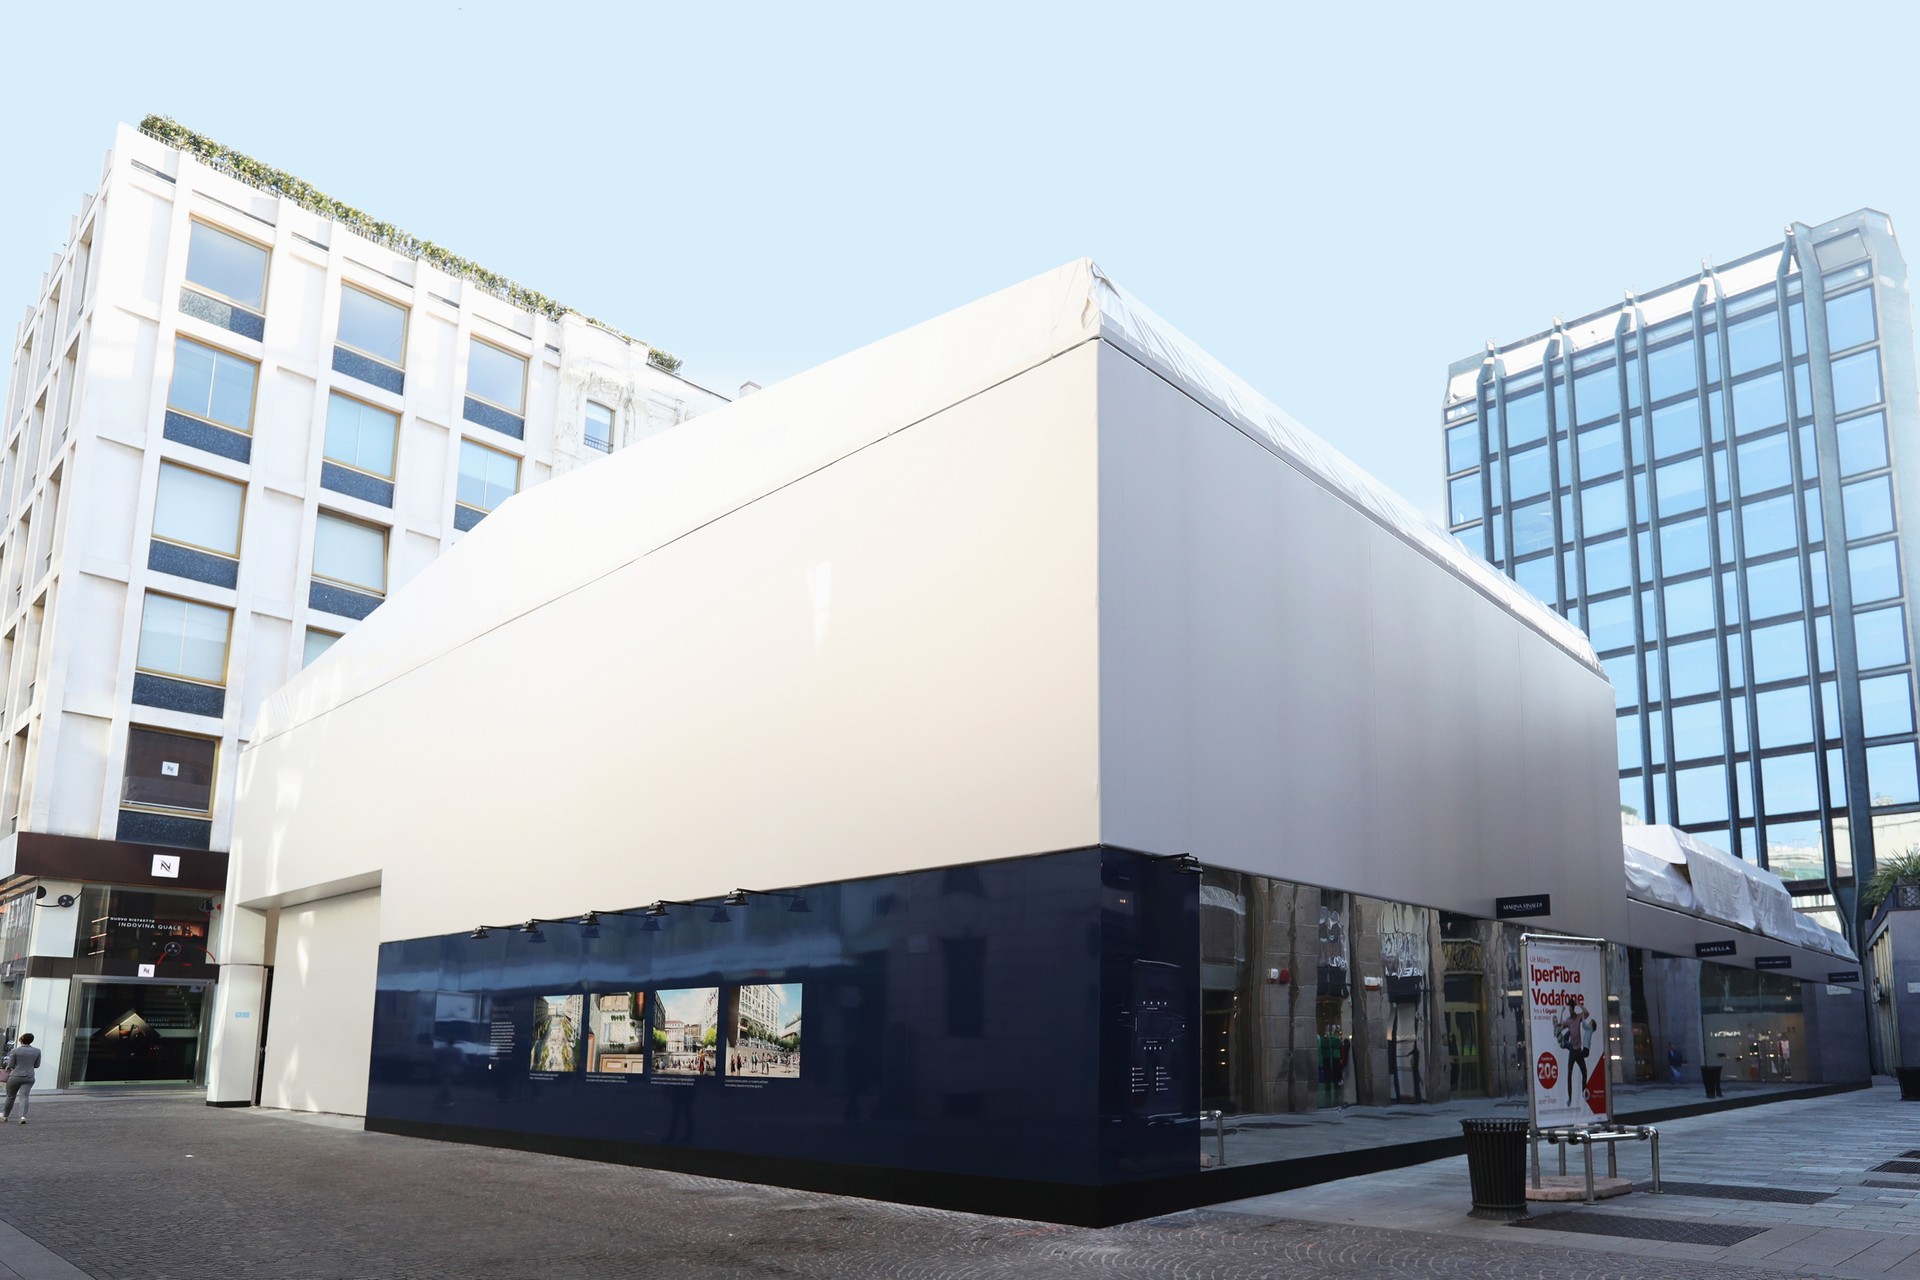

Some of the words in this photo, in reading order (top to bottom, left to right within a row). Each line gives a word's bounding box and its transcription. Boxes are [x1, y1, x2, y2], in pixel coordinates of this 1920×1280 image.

[160, 859, 172, 873] N
[1531, 964, 1580, 986] IperFibra
[1531, 988, 1585, 1006] Vodafone
[1538, 1063, 1557, 1079] 20€
